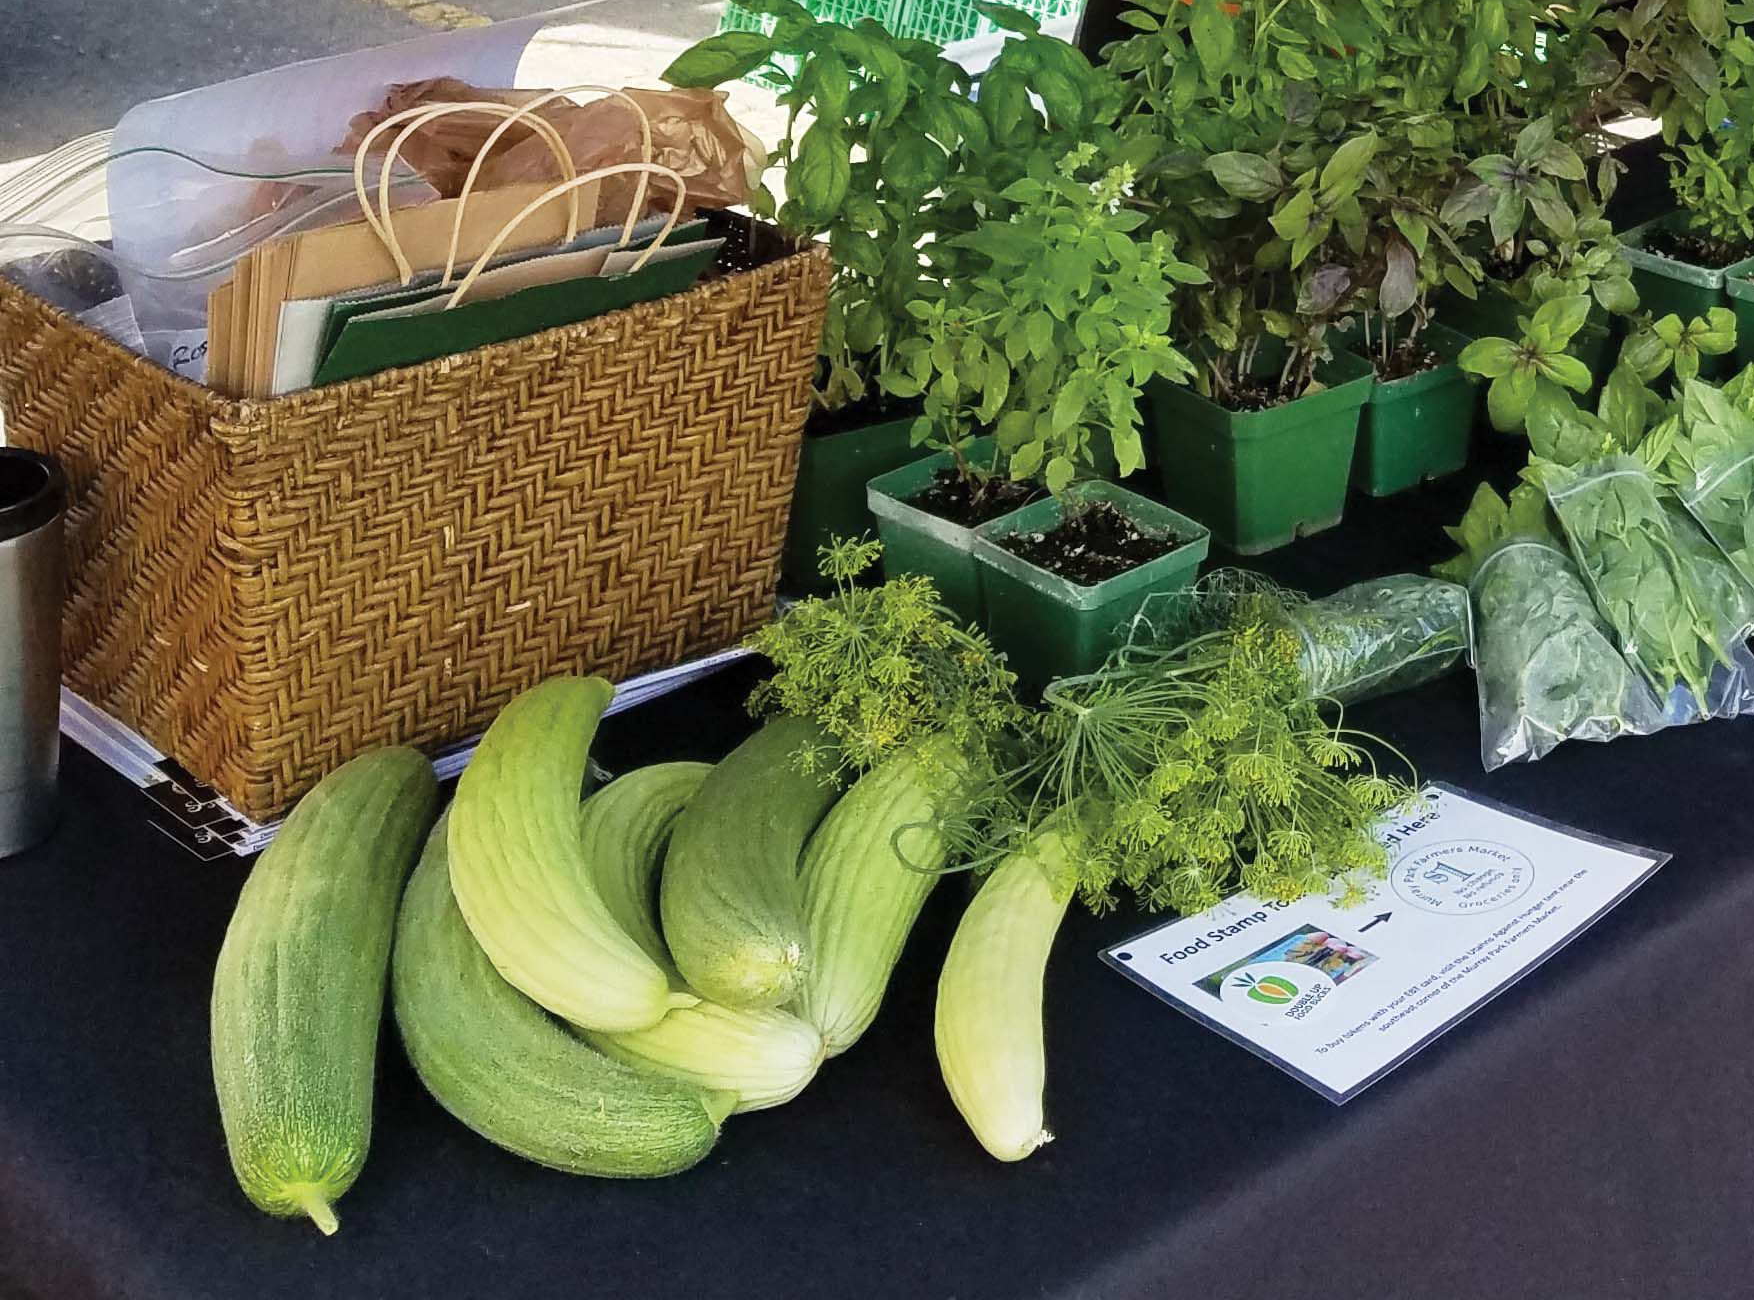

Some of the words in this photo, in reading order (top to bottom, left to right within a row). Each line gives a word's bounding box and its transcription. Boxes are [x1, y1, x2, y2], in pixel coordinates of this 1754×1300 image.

[1468, 846, 1511, 862] Market
[1403, 867, 1418, 882] Park
[1423, 861, 1476, 885] $1
[1160, 937, 1211, 965] Food
[1207, 911, 1268, 942] Stamp
[1397, 812, 1440, 836] Here
[1408, 885, 1442, 907] Murray
[1458, 885, 1516, 908] Groceries
[1416, 988, 1441, 1006] corner
[1449, 973, 1465, 984] the
[1461, 955, 1491, 973] Murray
[1488, 944, 1508, 956] Park
[1285, 993, 1315, 1017] DOUBLE
[1309, 983, 1323, 994] UP
[1294, 1005, 1313, 1020] FOOD
[1309, 987, 1331, 1006] BUCKS
[1325, 1038, 1345, 1048] buy
[1341, 1021, 1371, 1038] tokens
[1368, 1008, 1388, 1021] with
[1386, 995, 1406, 1009] your
[1403, 986, 1420, 996] EBT
